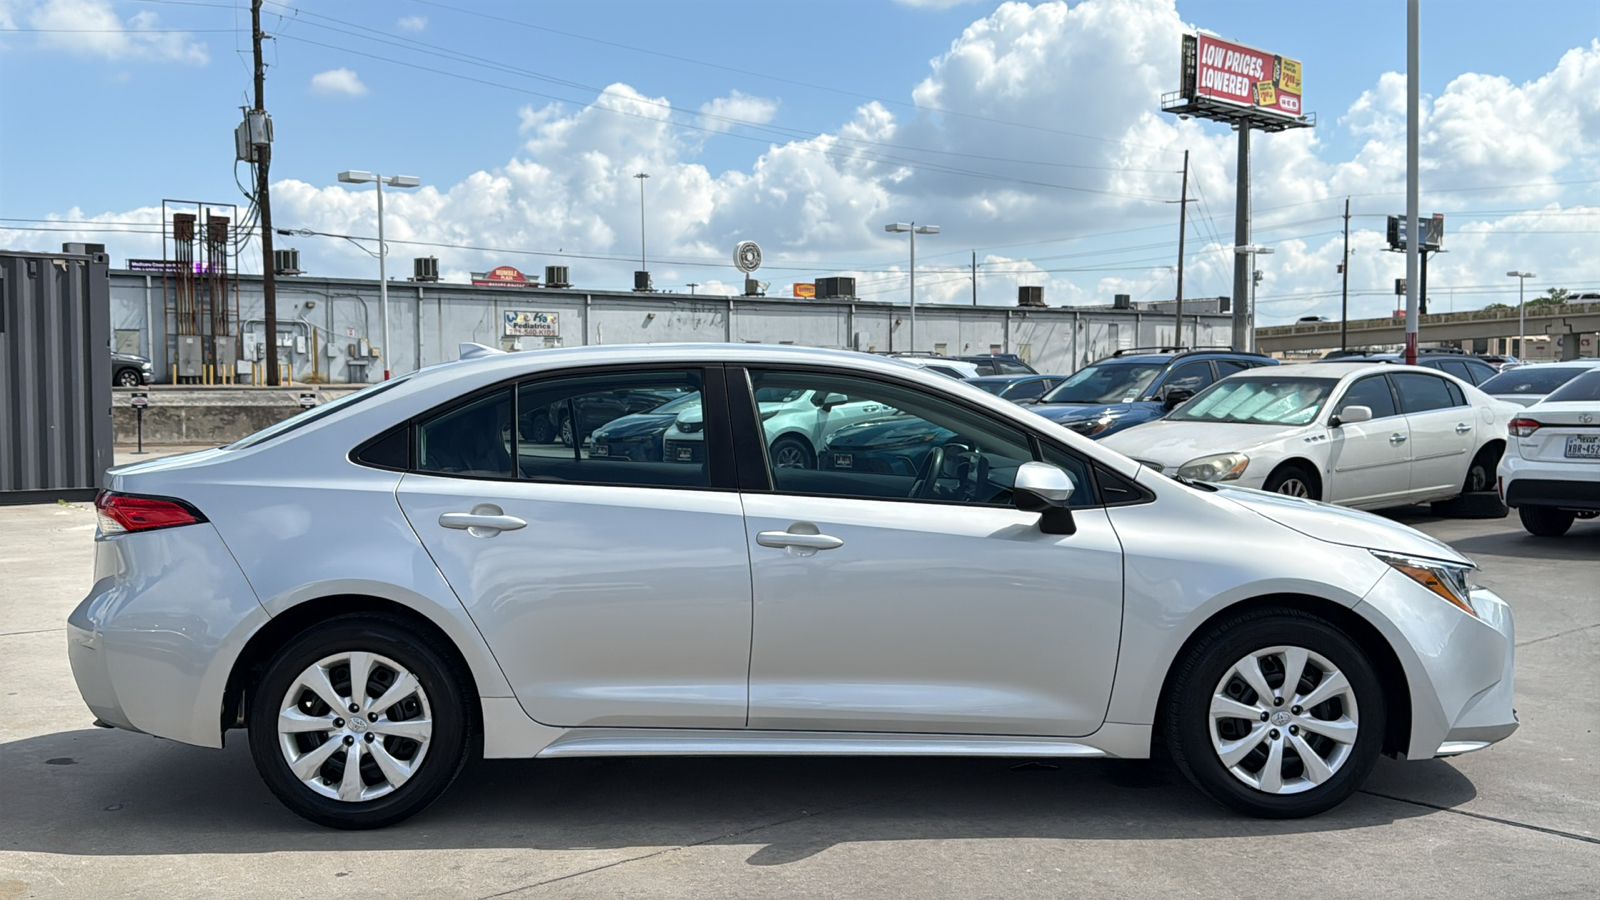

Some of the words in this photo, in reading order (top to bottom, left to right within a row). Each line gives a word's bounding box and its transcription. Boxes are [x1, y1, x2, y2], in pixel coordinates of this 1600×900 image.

[1201, 43, 1226, 68] LOW
[1224, 50, 1264, 81] PRICES,
[1201, 67, 1249, 97] LOWERED
[507, 311, 531, 322] Wee
[533, 312, 558, 324] Kare
